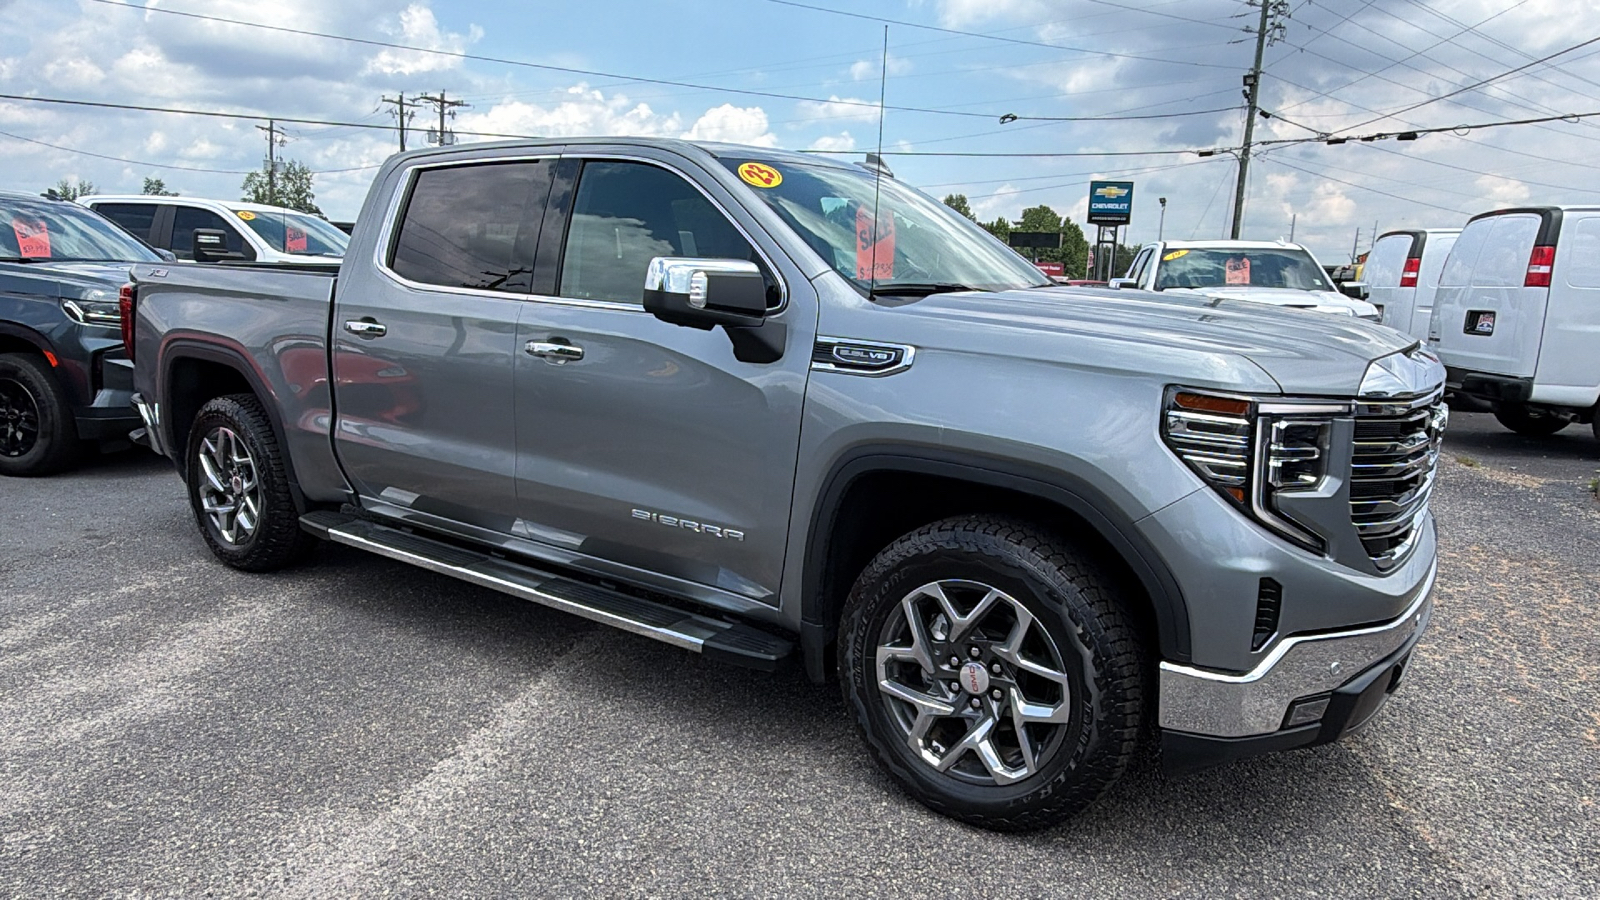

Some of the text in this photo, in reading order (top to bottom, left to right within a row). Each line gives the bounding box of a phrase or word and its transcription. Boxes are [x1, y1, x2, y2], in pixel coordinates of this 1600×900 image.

[743, 164, 776, 186] 23
[1091, 202, 1129, 210] CHEVROLET
[859, 219, 893, 251] SALE
[1228, 261, 1248, 272] SALE
[631, 508, 745, 542] SIERRA
[969, 665, 979, 693] GMC
